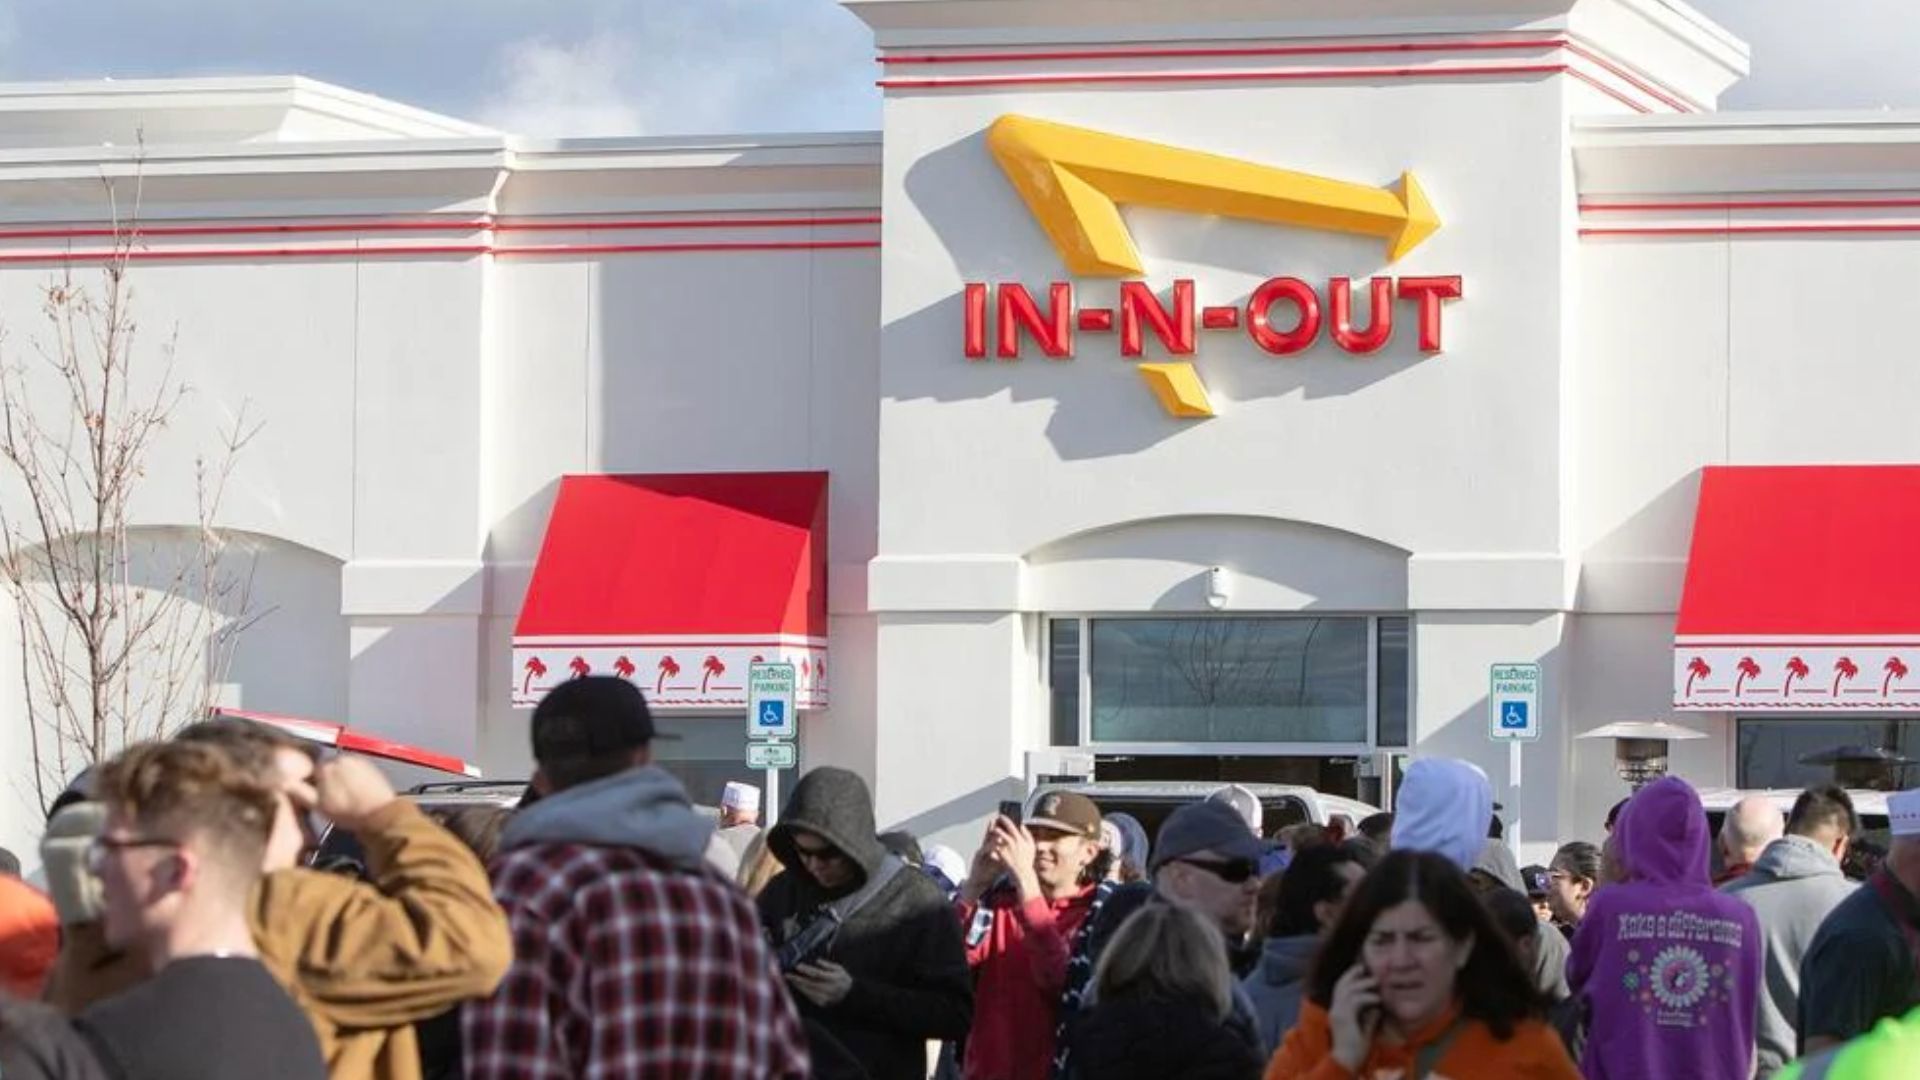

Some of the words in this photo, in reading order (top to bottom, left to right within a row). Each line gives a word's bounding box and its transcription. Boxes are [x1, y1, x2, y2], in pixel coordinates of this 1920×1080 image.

[965, 276, 1462, 357] IN-N-OUT
[752, 669, 792, 680] RESERVED
[1494, 669, 1537, 680] RESERVED
[754, 682, 790, 692] PARKING
[1496, 682, 1534, 693] PARKING
